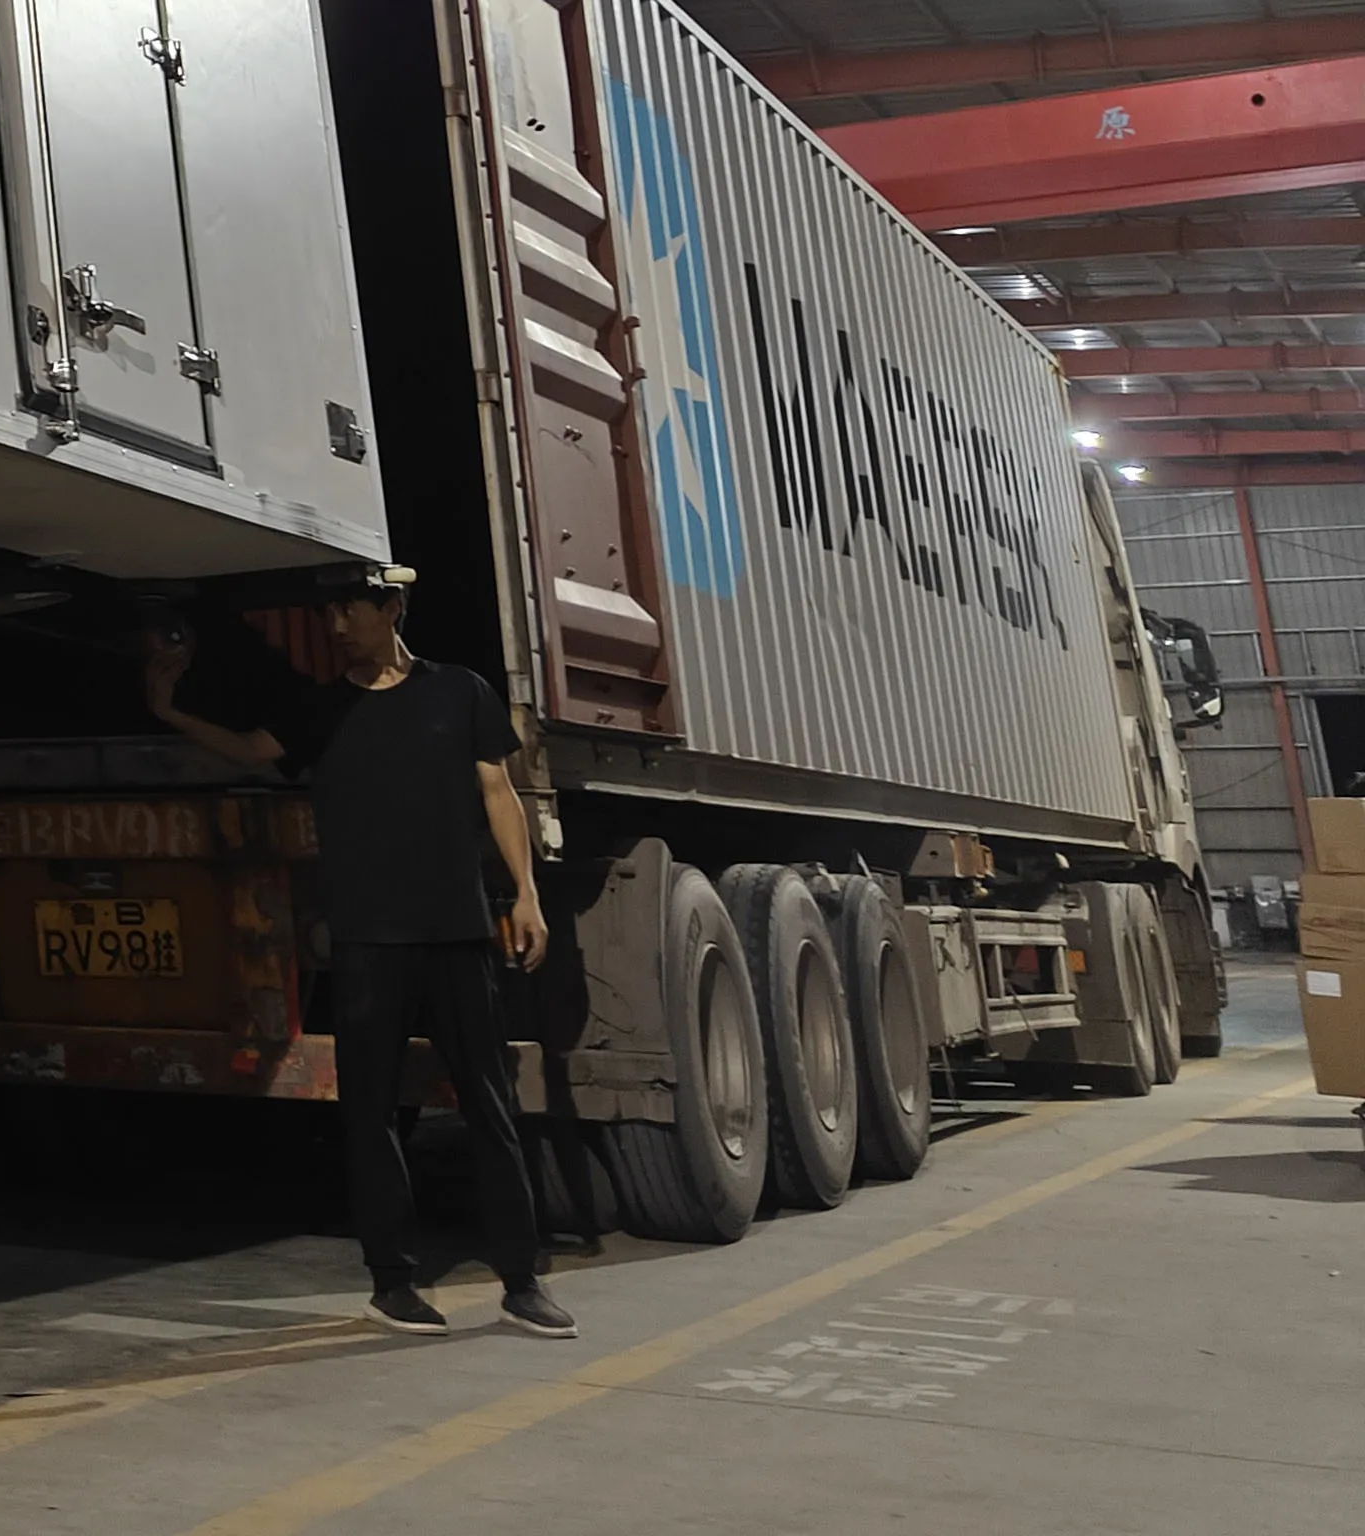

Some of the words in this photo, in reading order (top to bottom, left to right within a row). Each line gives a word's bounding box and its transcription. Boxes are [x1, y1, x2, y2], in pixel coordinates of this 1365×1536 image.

[1095, 105, 1136, 141] 原
[744, 262, 1069, 652] MAERSK
[44, 930, 177, 972] RV98挂
